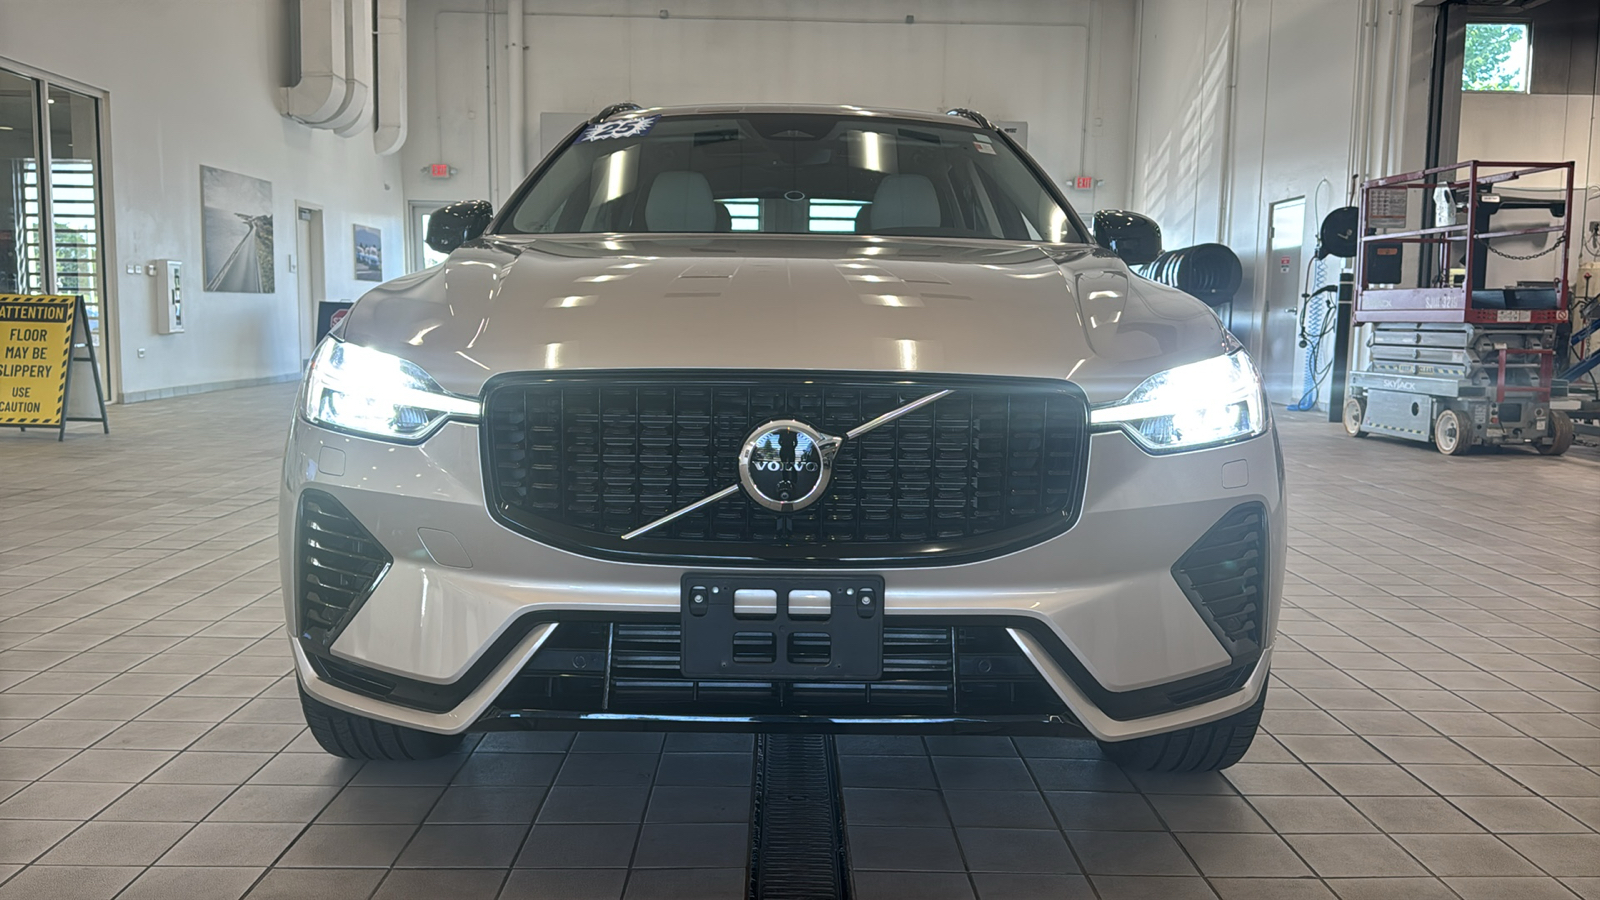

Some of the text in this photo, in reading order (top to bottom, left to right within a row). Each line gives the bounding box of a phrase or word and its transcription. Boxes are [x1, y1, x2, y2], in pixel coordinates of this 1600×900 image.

[594, 121, 639, 137] 25
[1077, 176, 1092, 188] EXIT
[0, 305, 64, 320] ATTENTION
[10, 328, 48, 342] FLOOR
[5, 346, 48, 360] MAY BE
[12, 387, 31, 398] USE
[0, 401, 41, 413] CAUTION
[752, 461, 819, 472] VOLVO
